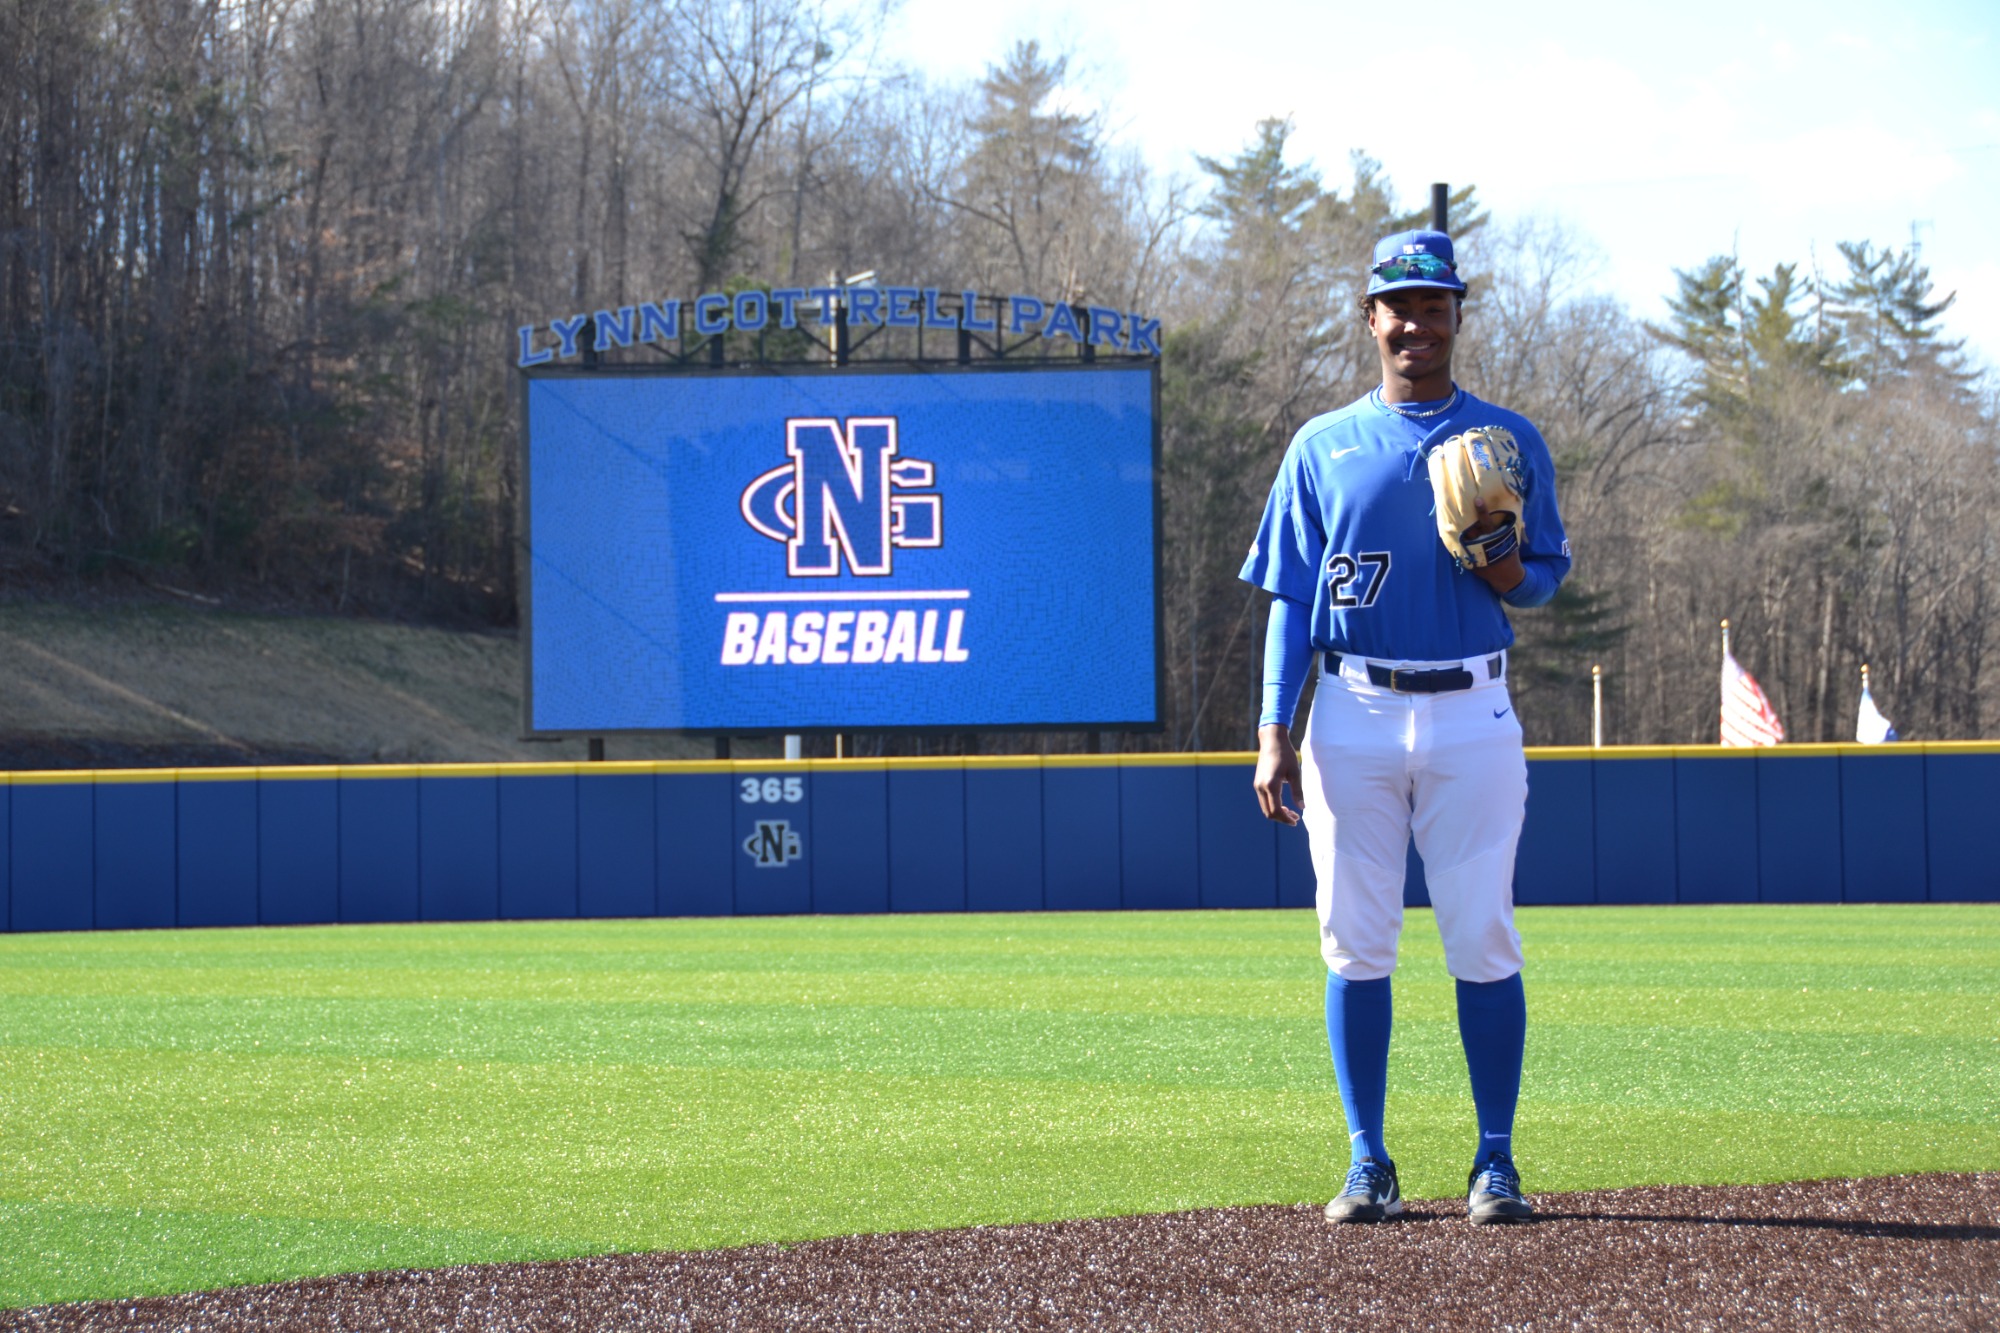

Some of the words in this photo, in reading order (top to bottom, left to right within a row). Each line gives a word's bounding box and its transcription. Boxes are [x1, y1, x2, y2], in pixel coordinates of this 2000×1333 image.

[518, 299, 681, 367] LYNN
[695, 287, 996, 334] COTTRELL
[1009, 295, 1161, 356] PARK
[1326, 551, 1391, 610] 27
[720, 609, 969, 665] BASEBALL
[740, 777, 803, 803] 365
